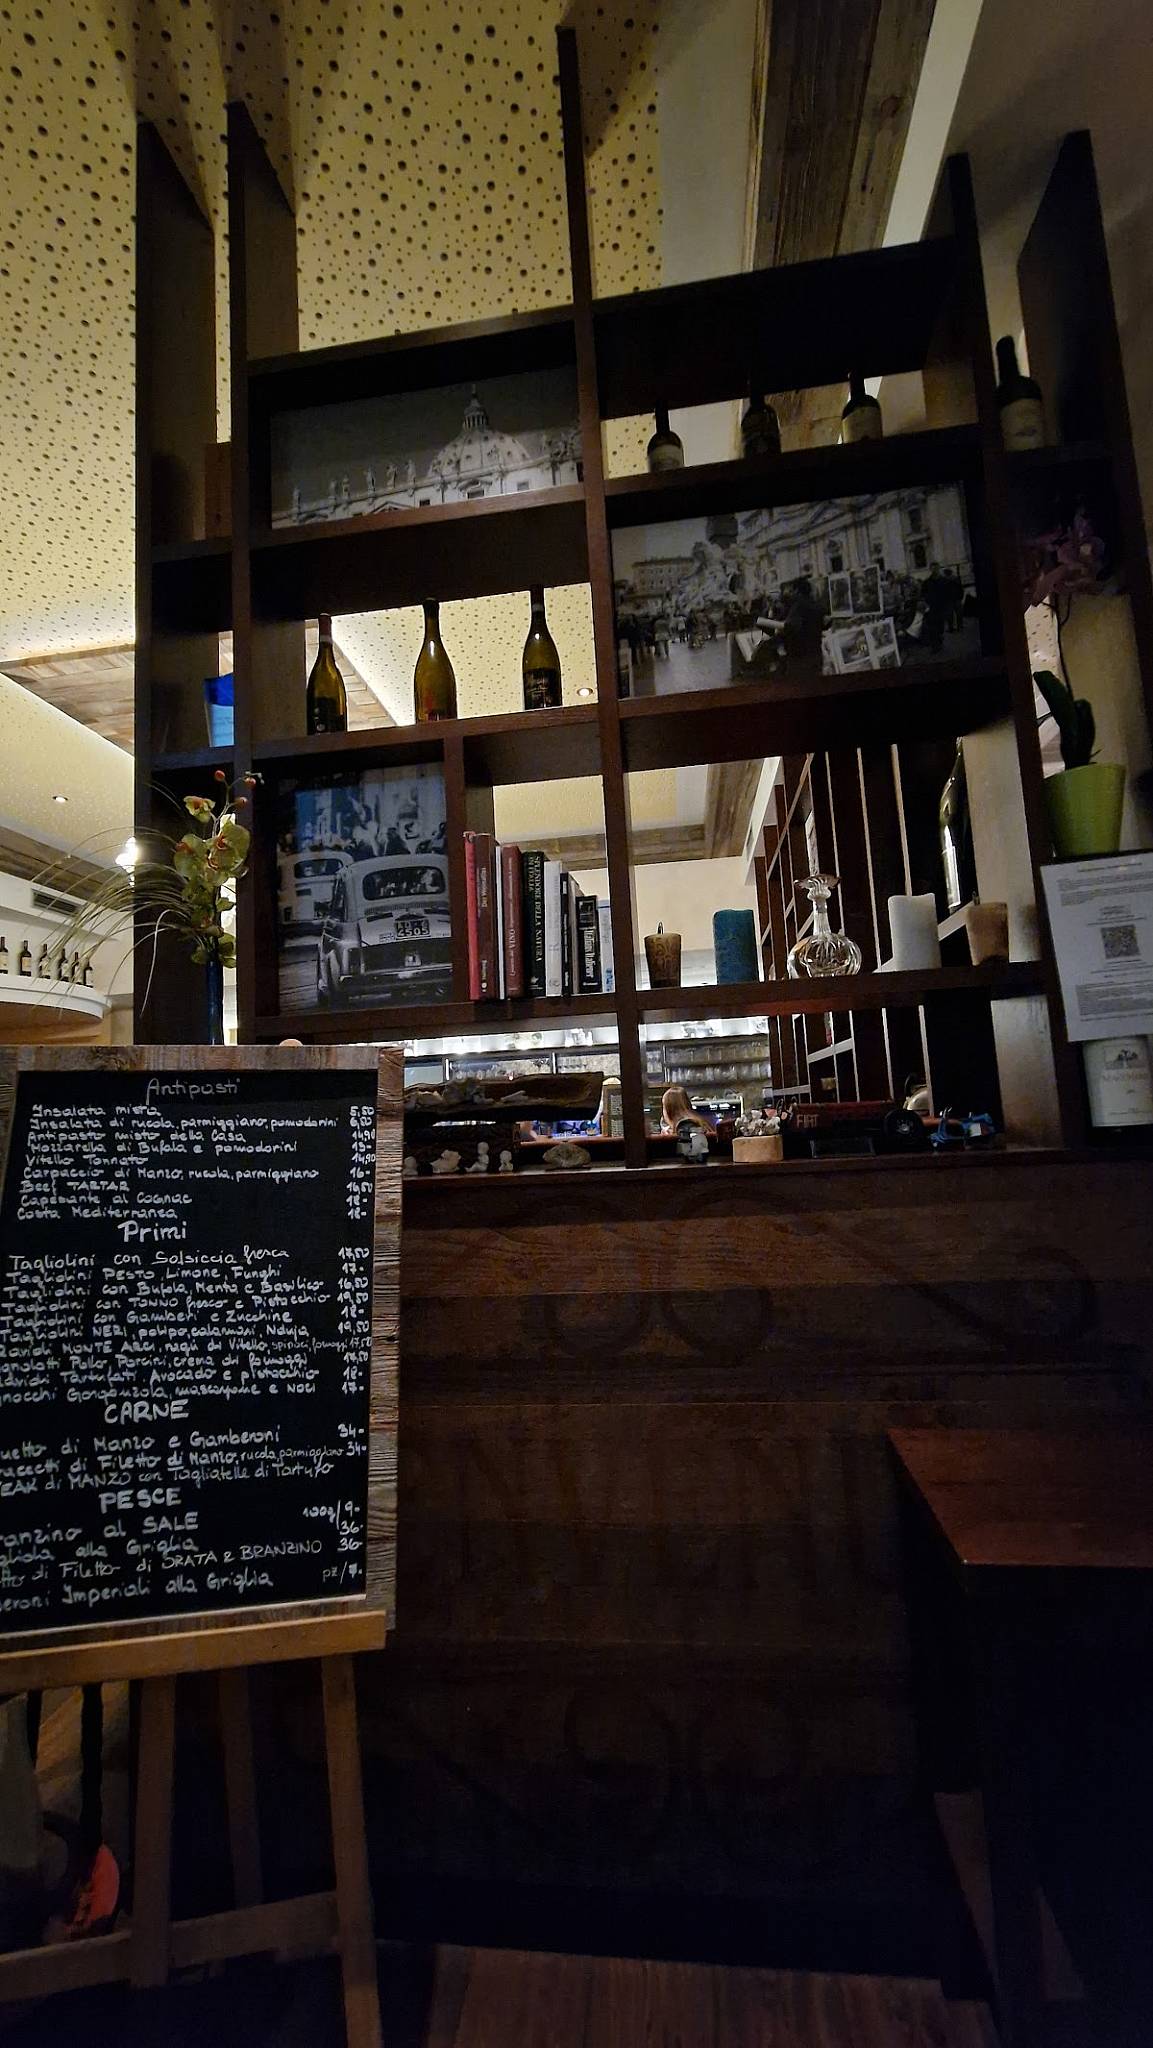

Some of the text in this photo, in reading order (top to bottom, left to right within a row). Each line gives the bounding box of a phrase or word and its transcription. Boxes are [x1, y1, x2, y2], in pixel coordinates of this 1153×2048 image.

[508, 928, 516, 949] VINO
[146, 1078, 241, 1105] Antipasti
[32, 1104, 106, 1117] Insalata
[115, 1104, 161, 1117] mista
[30, 1118, 103, 1130] Insalata
[109, 1117, 125, 1128] di
[27, 1131, 106, 1146] Antipasto
[115, 1131, 160, 1141] misto
[211, 1129, 246, 1142] Casa
[30, 1141, 107, 1153] Mozzarella
[117, 1142, 132, 1152] di
[138, 1140, 187, 1155] Bufala
[193, 1144, 203, 1154] e
[214, 1140, 298, 1156] pomodorini
[25, 1154, 75, 1166] Vitello
[82, 1153, 149, 1165] Tonnato
[23, 1167, 104, 1182] Carpaccio
[115, 1168, 130, 1178] di
[20, 1179, 57, 1196] Beef
[66, 1180, 130, 1192] TARTAR
[112, 1193, 129, 1204] al
[136, 1192, 193, 1205] Cognac
[71, 1205, 179, 1219] Mediterranea
[117, 1220, 188, 1243] Primi
[9, 1253, 96, 1274] Tagliolini
[113, 1254, 142, 1265] con
[6, 1268, 92, 1289] Tagliolini
[231, 1264, 282, 1283] Funghi
[3, 1283, 91, 1302] Tagliolini
[102, 1283, 129, 1295] con
[244, 1283, 255, 1294] e
[259, 1276, 325, 1294] Basilico
[0, 1299, 86, 1319] Tagliolini
[96, 1299, 121, 1310] con
[128, 1297, 179, 1307] TONNO
[234, 1299, 244, 1309] e
[251, 1292, 330, 1308] Pistacchio
[0, 1314, 83, 1333] Tagliolini
[93, 1313, 116, 1324] con
[126, 1310, 199, 1325] Gamberi
[210, 1313, 220, 1323] e
[225, 1310, 293, 1323] Zucchine
[62, 1340, 113, 1355] MONTE
[207, 1337, 222, 1351] di
[0, 1357, 61, 1373] gnolotti
[221, 1352, 239, 1366] di
[149, 1369, 217, 1392] Avocado
[222, 1369, 232, 1380] e
[269, 1383, 279, 1394] e
[286, 1382, 316, 1393] NOCI
[104, 1398, 190, 1425] CARNE
[0, 1440, 47, 1460] uetto
[60, 1437, 81, 1455] di
[93, 1436, 155, 1452] Manzo
[168, 1434, 182, 1449] e
[189, 1424, 281, 1450] Gamberoni
[69, 1457, 88, 1473] di
[97, 1451, 162, 1471] Filetto
[167, 1450, 184, 1470] di
[45, 1473, 62, 1490] di
[67, 1471, 131, 1490] MANZO
[138, 1471, 163, 1482] con
[167, 1464, 251, 1489] Tagliatelle
[253, 1461, 269, 1477] di
[271, 1459, 335, 1478] Tartufo
[98, 1487, 182, 1514] PESCE
[103, 1519, 127, 1538] al
[141, 1511, 199, 1534] SALE
[75, 1541, 109, 1557] alla
[126, 1536, 200, 1558] Griglia
[0, 1567, 26, 1588] tto
[32, 1564, 49, 1580] di
[59, 1560, 121, 1579] Filetto
[136, 1558, 152, 1573] di
[161, 1550, 218, 1569] ORATA
[239, 1539, 322, 1560] BRANZINO
[0, 1592, 49, 1612] eroni
[61, 1575, 151, 1608] Imperiali
[165, 1574, 198, 1593] alla
[206, 1566, 274, 1594] Griglia
